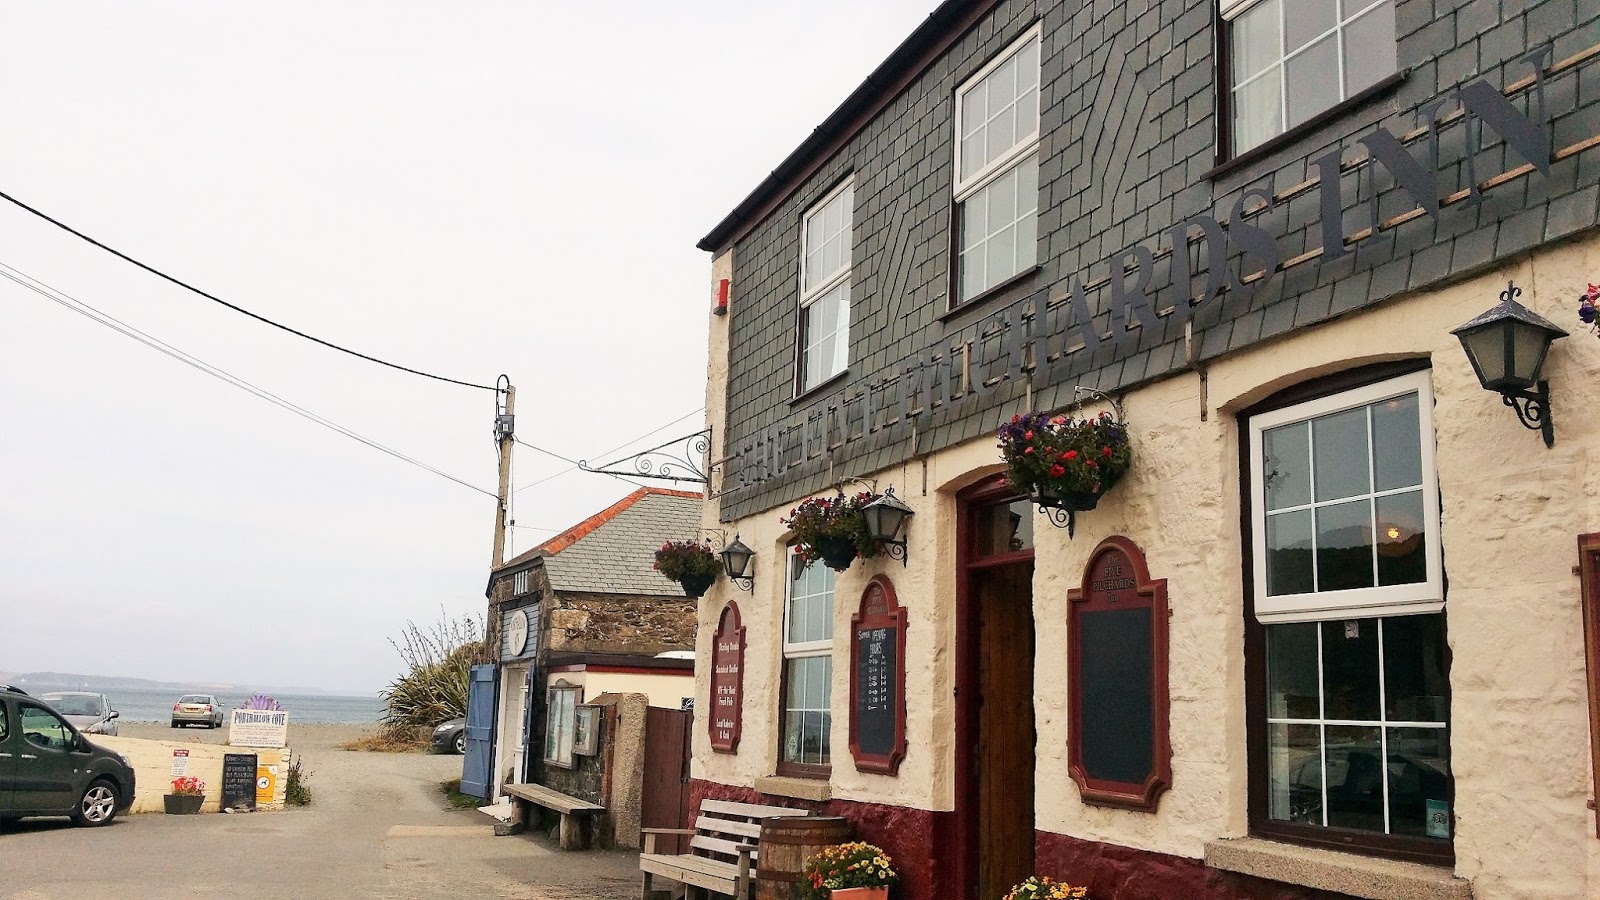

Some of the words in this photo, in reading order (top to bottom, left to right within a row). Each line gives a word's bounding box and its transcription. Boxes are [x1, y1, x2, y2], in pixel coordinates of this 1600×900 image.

[801, 378, 883, 463] FIVE
[899, 179, 1278, 428] PILCHARDS
[1309, 42, 1554, 267] INN
[1104, 566, 1121, 577] FIVE
[1093, 578, 1135, 591] PILCHARDS
